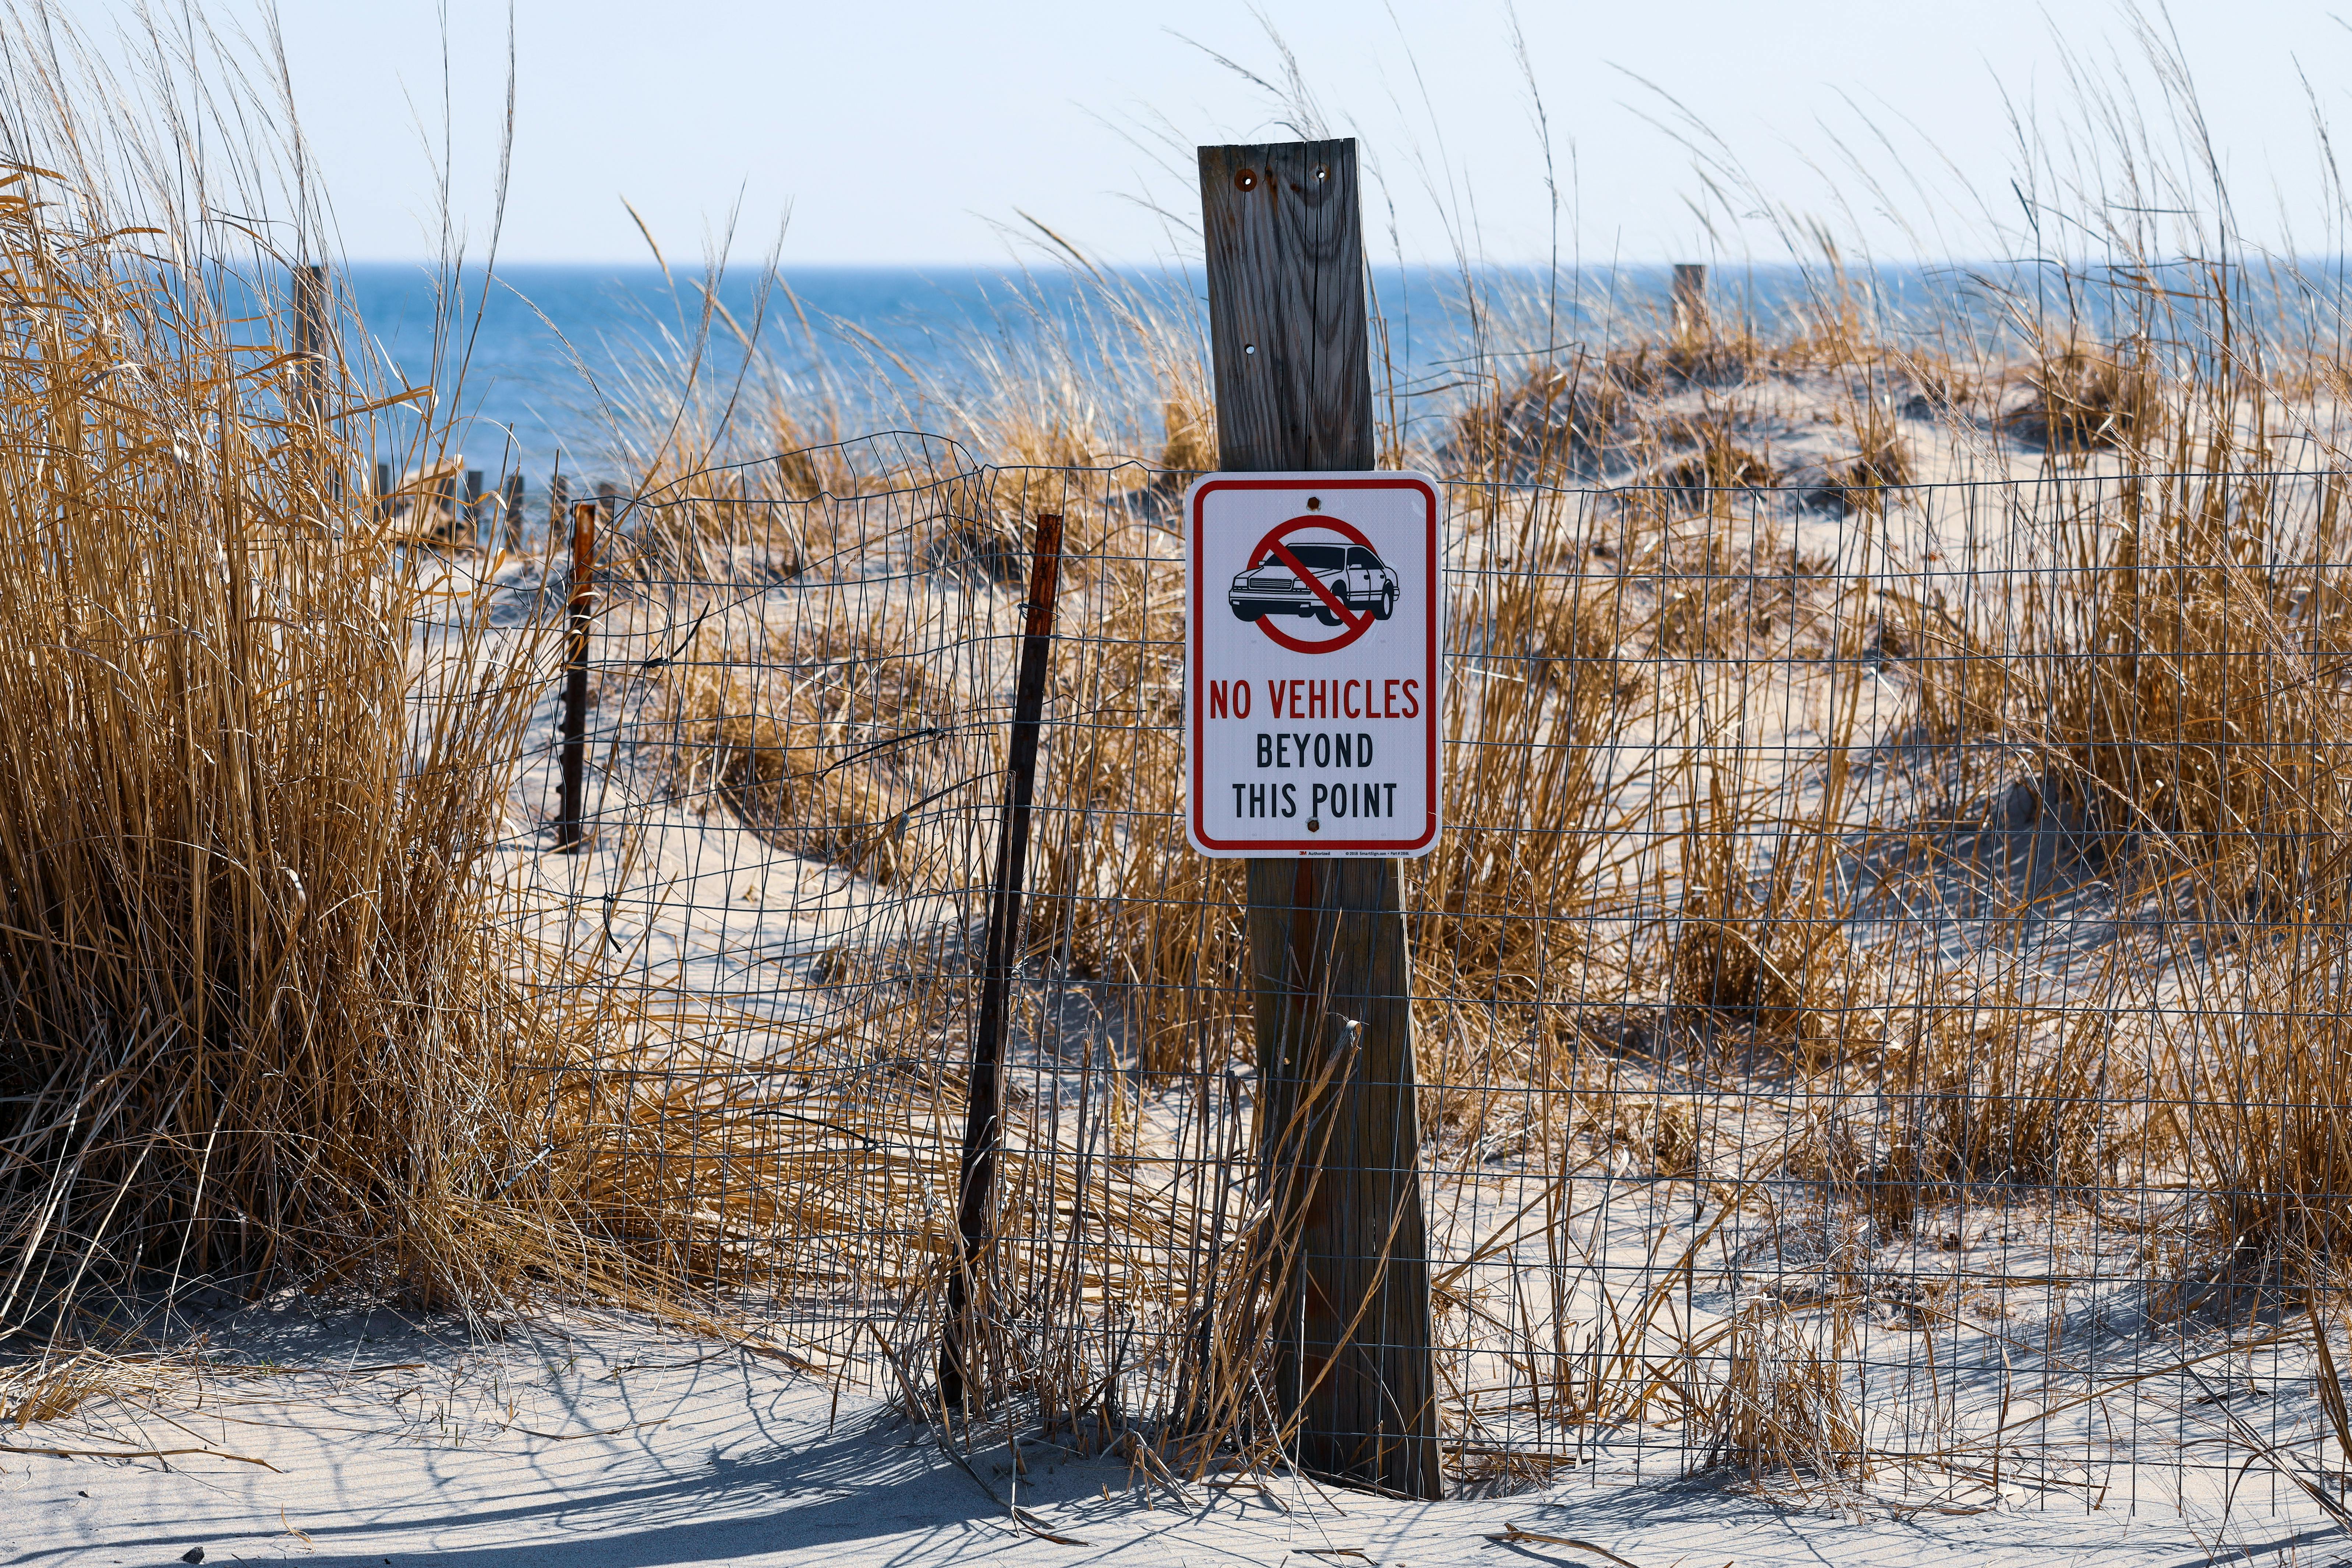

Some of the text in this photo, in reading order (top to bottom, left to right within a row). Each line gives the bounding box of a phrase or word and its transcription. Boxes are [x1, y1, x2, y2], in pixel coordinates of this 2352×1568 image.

[1210, 679, 1419, 719] NO VEHICLES
[1257, 733, 1373, 768] BEYOND
[1232, 783, 1397, 818] THIS POINT
